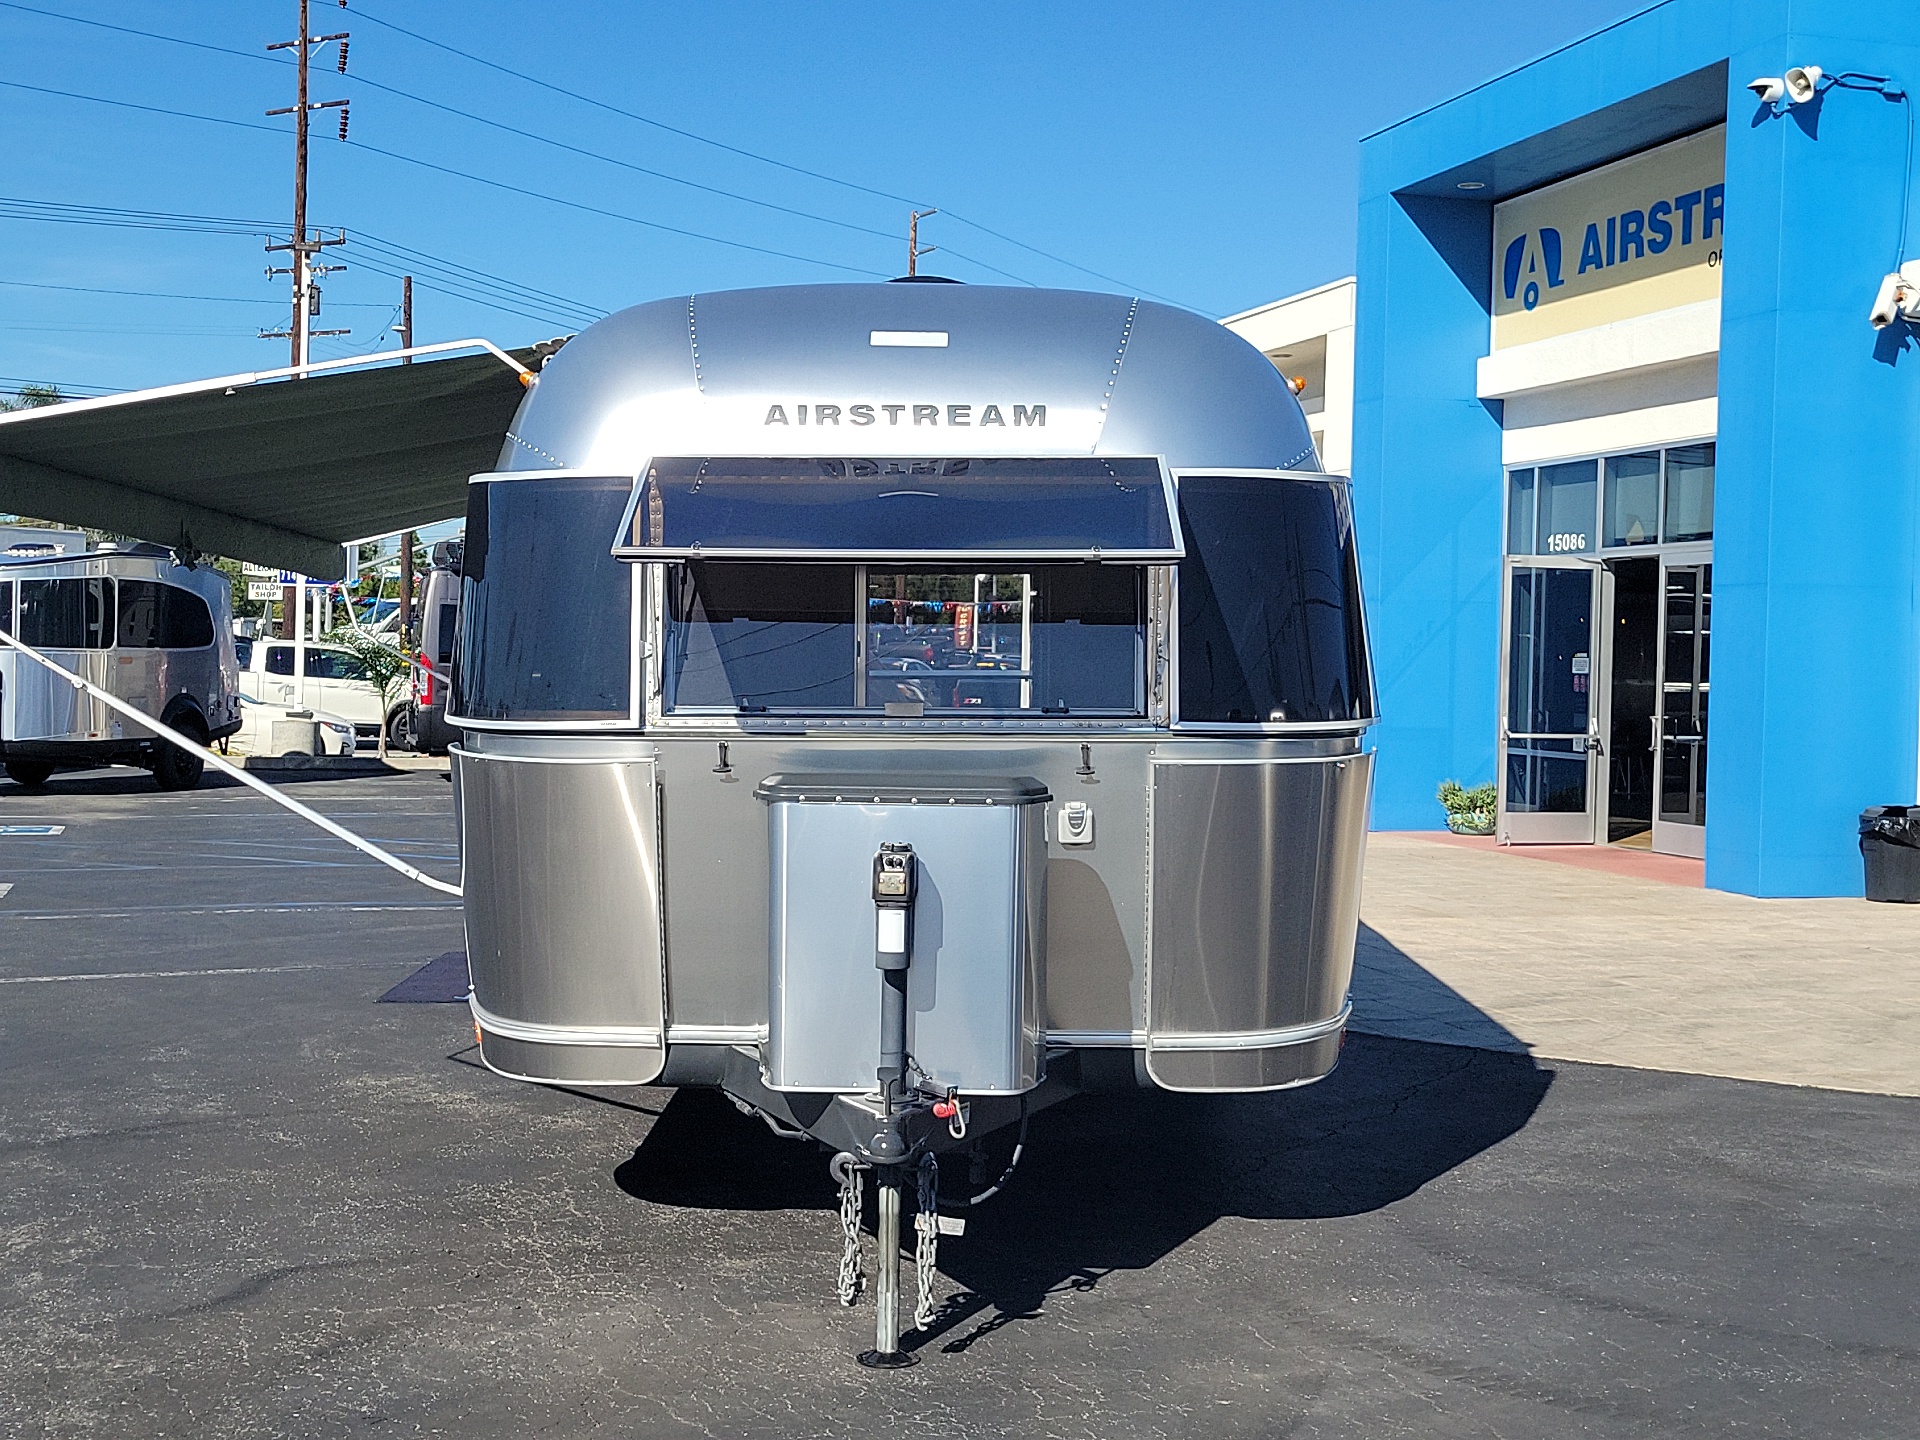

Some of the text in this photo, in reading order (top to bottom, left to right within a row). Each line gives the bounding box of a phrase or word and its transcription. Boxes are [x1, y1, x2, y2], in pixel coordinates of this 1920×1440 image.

[1577, 183, 1724, 275] AIRSTR
[764, 404, 1047, 426] AIRSTREAM
[1547, 533, 1586, 551] 15086
